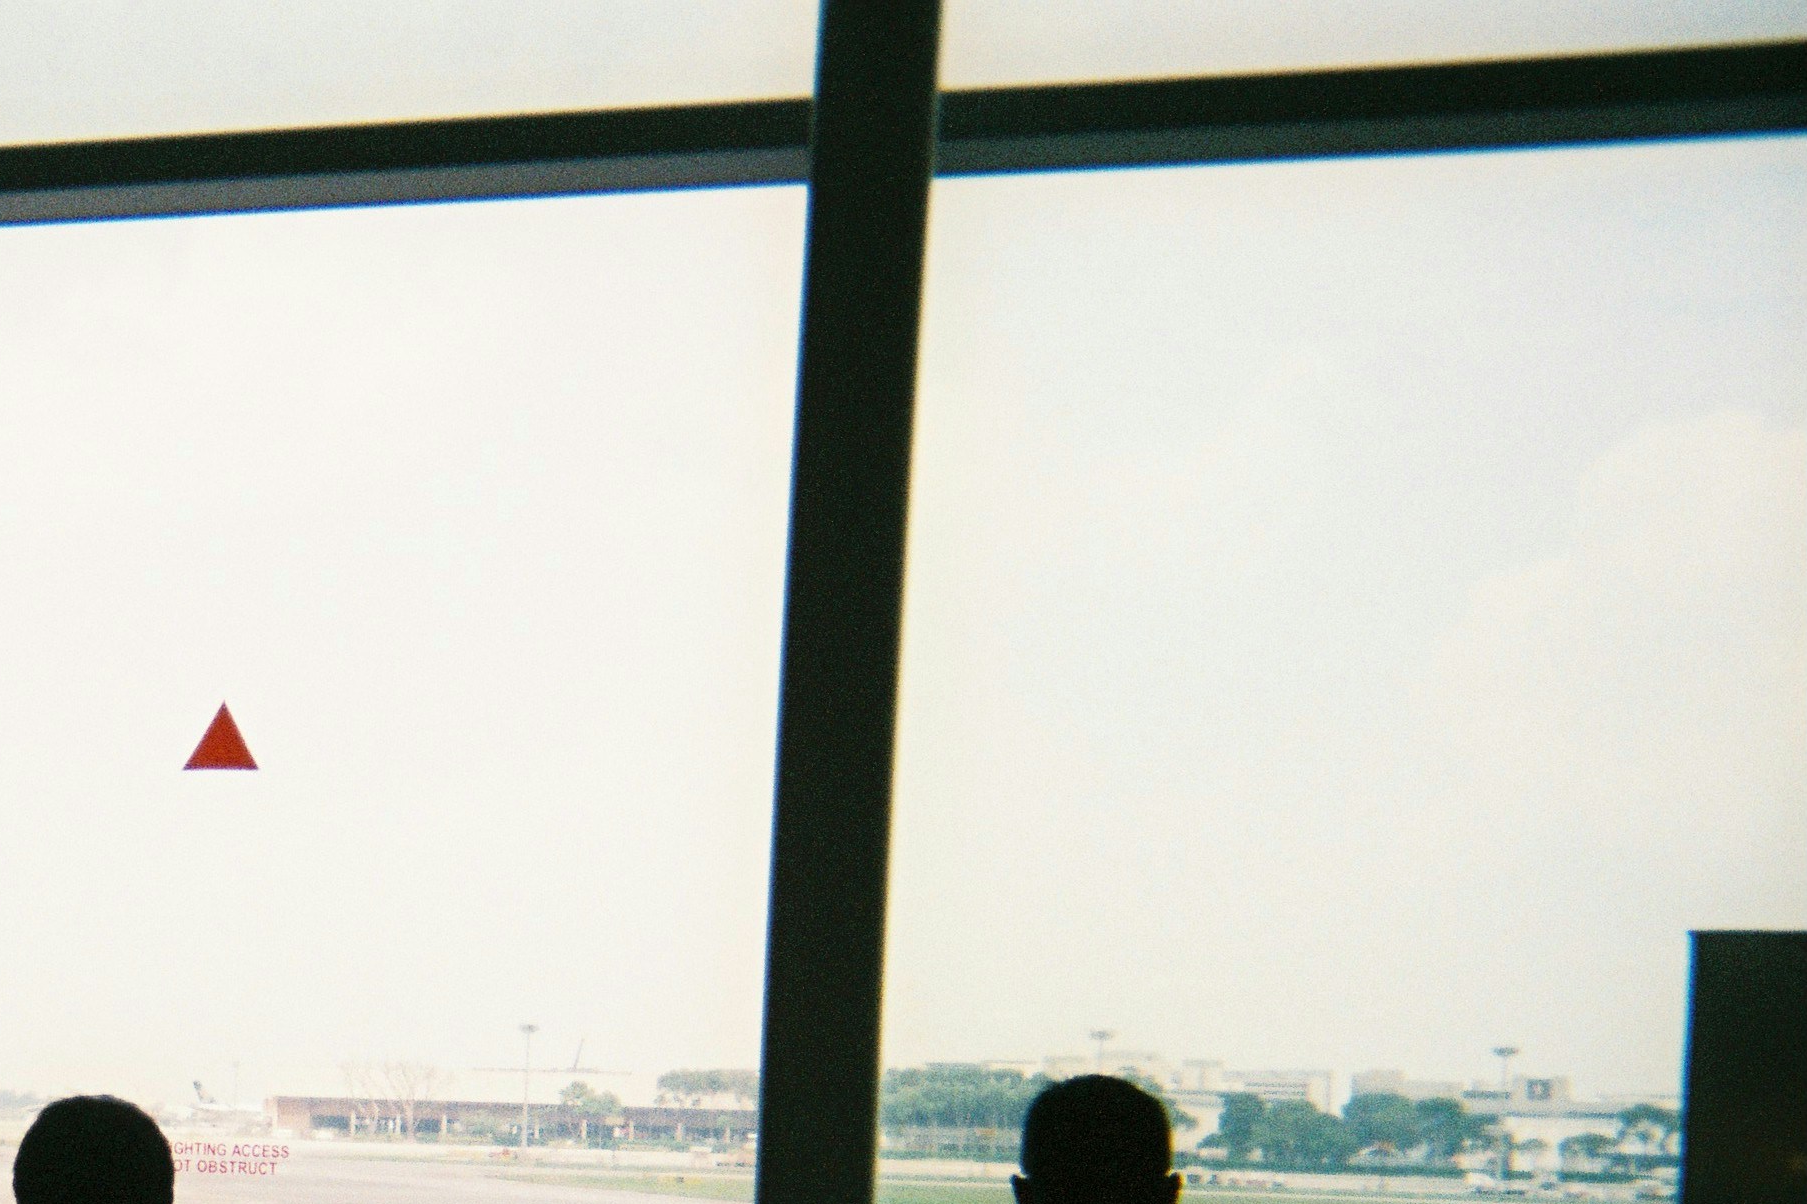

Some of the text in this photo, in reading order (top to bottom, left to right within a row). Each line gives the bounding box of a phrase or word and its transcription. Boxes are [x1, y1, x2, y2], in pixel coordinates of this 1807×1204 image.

[232, 1144, 290, 1159] ACCESS
[173, 1159, 278, 1175] OT OBSTRUCT
